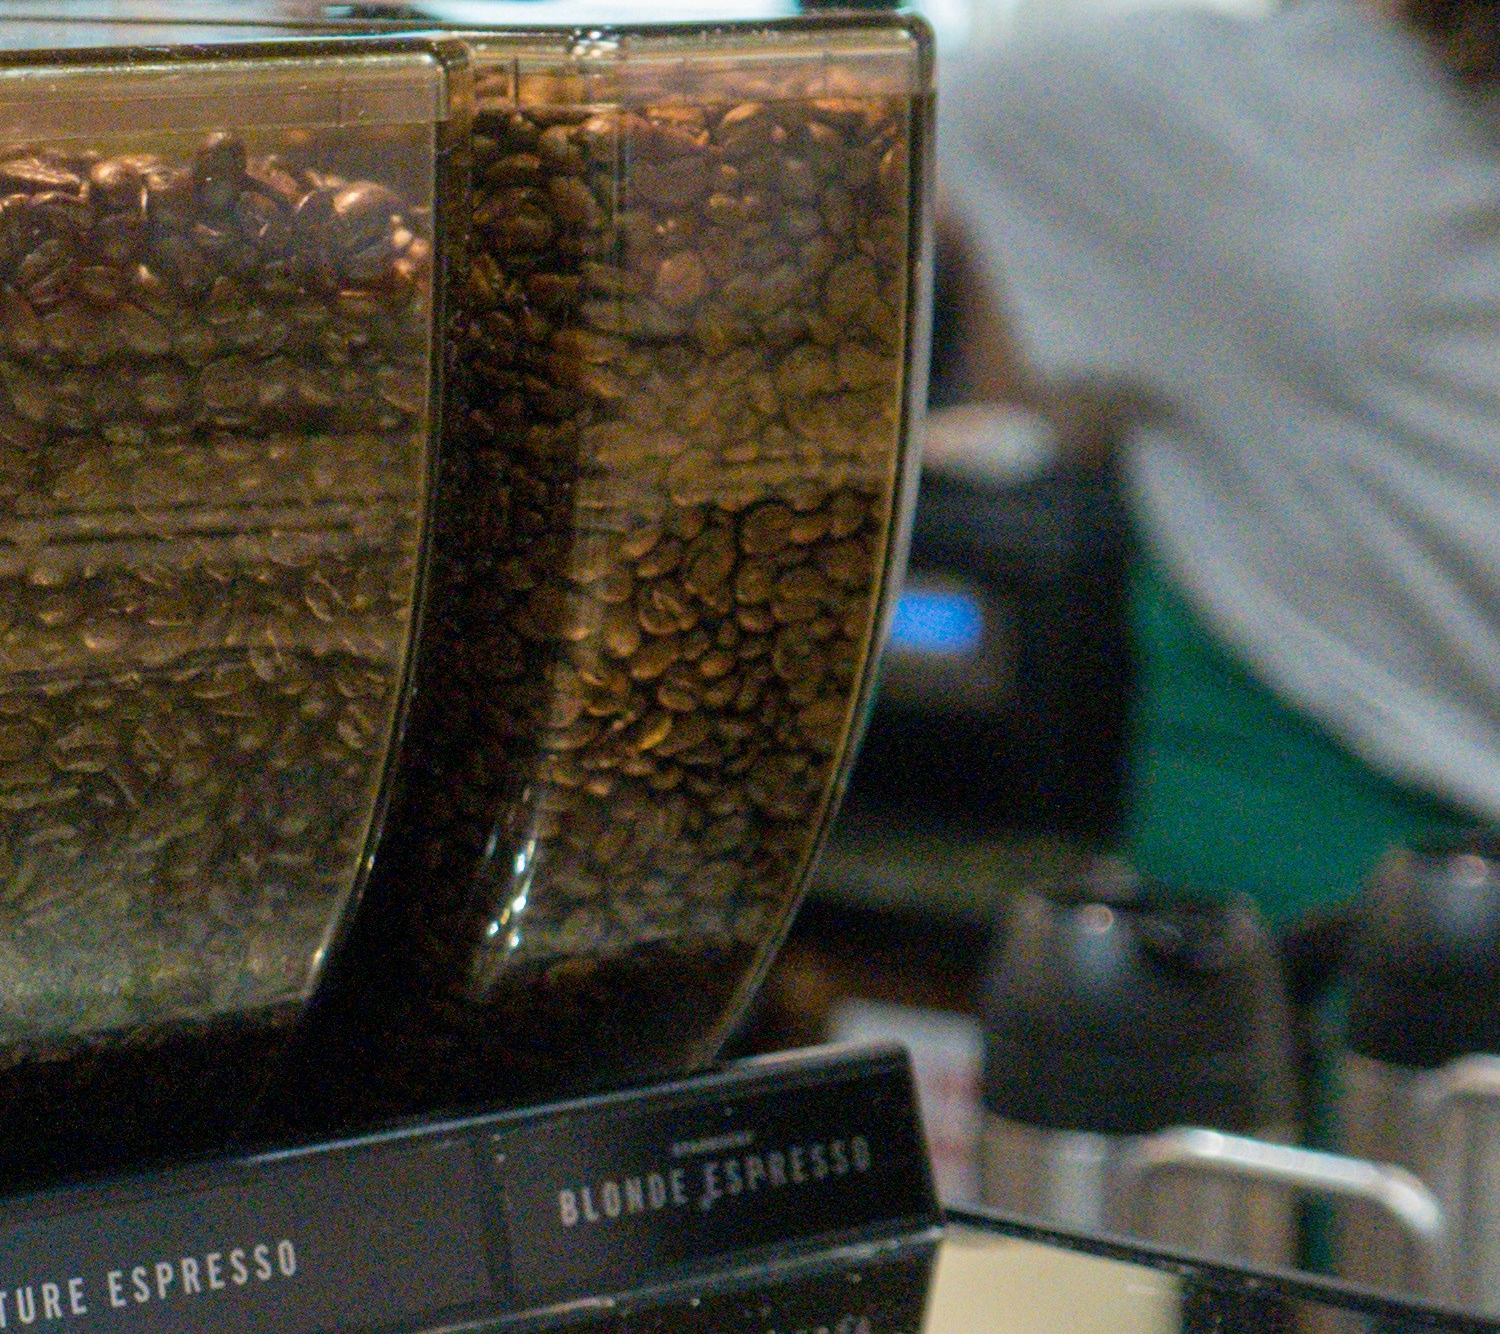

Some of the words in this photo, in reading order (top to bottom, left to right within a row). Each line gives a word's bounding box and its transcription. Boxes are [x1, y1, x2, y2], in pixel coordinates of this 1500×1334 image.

[559, 1166, 688, 1227] BLONDE
[701, 1135, 872, 1203] ESPRESSO
[107, 1238, 298, 1310] ESPRESSO
